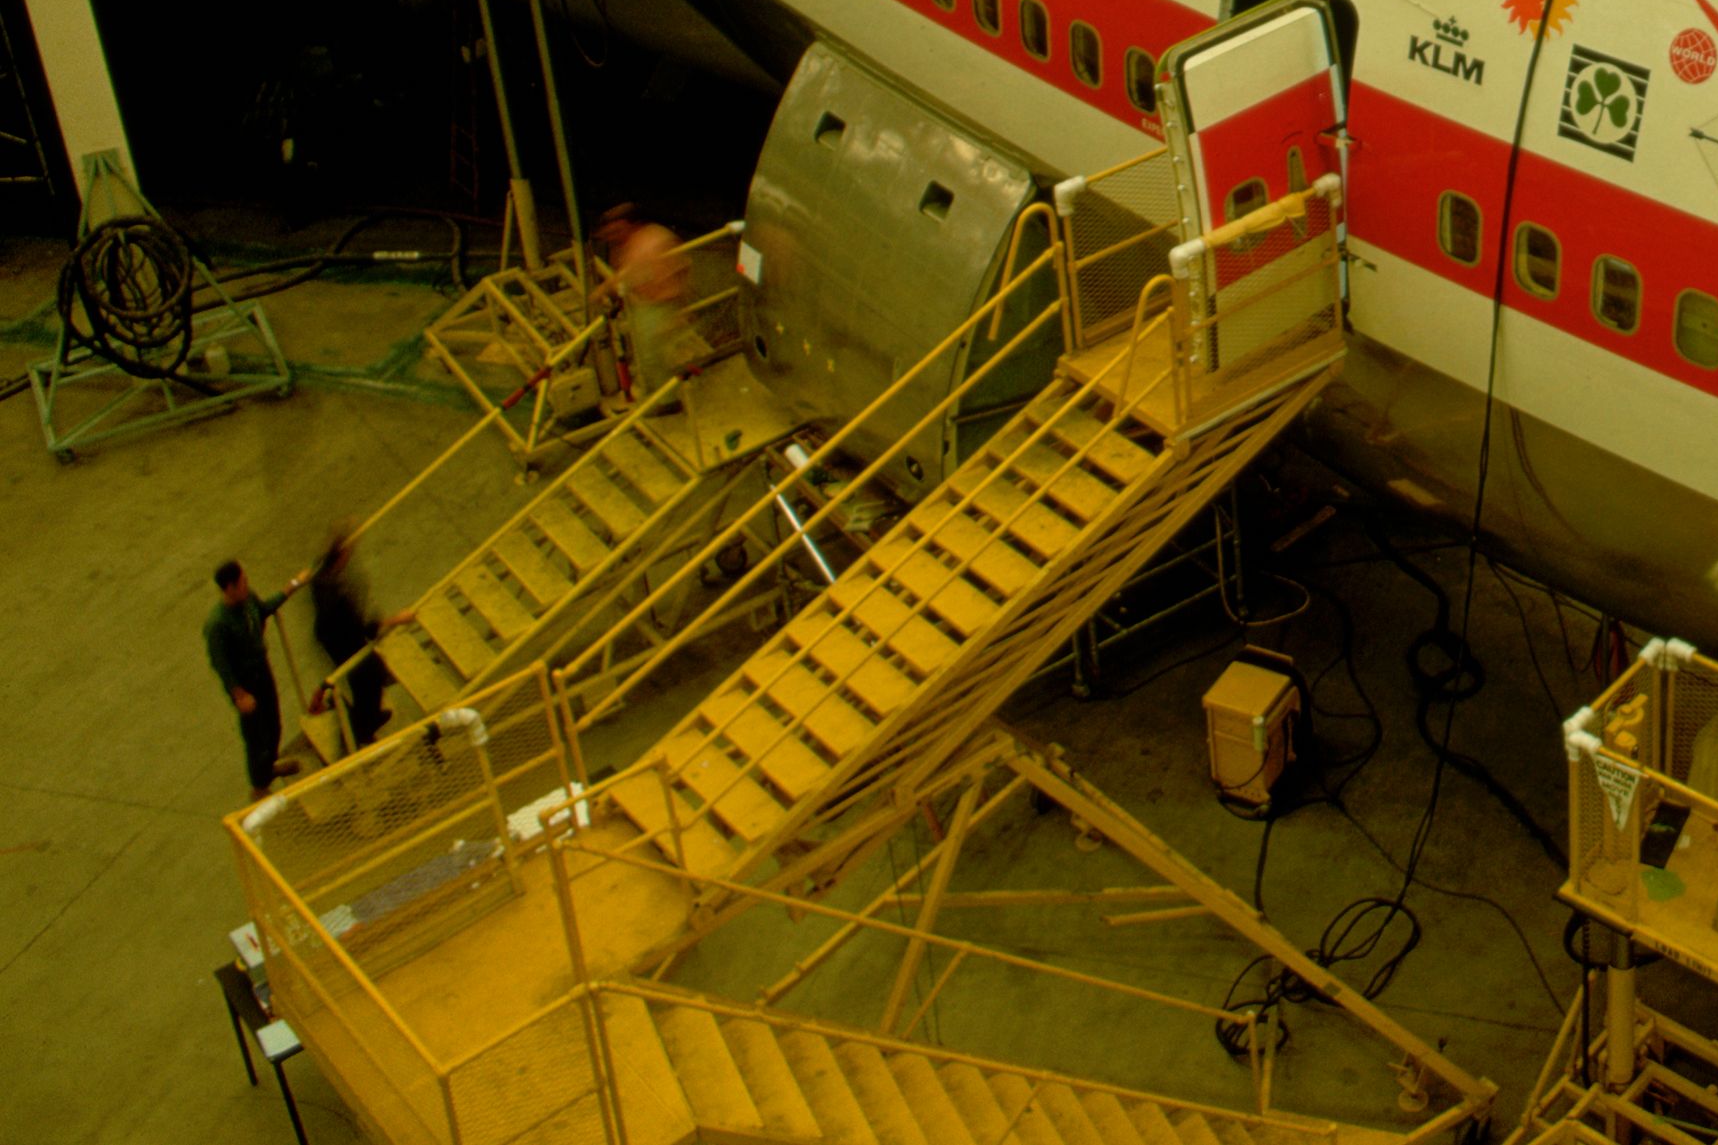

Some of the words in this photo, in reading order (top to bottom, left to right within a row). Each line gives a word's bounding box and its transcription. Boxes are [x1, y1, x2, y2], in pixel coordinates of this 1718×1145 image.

[1408, 35, 1485, 86] KLM
[1671, 45, 1716, 67] WORLD
[1595, 760, 1636, 784] CAUTION
